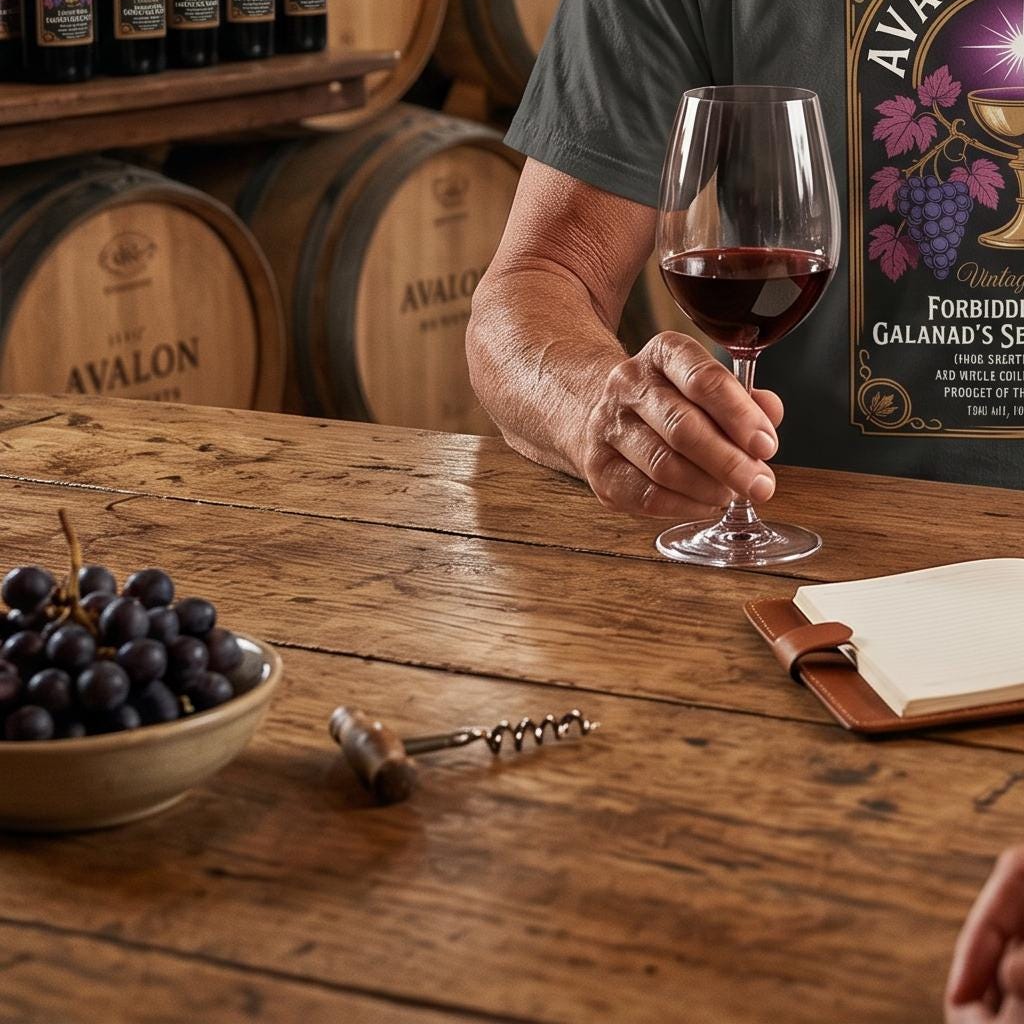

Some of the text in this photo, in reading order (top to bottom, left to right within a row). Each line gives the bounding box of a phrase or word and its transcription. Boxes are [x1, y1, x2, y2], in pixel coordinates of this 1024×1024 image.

[400, 267, 487, 312] AVALO
[872, 321, 994, 346] GALANAD'S
[66, 337, 200, 397] AVALON
[995, 387, 1010, 398] OF
